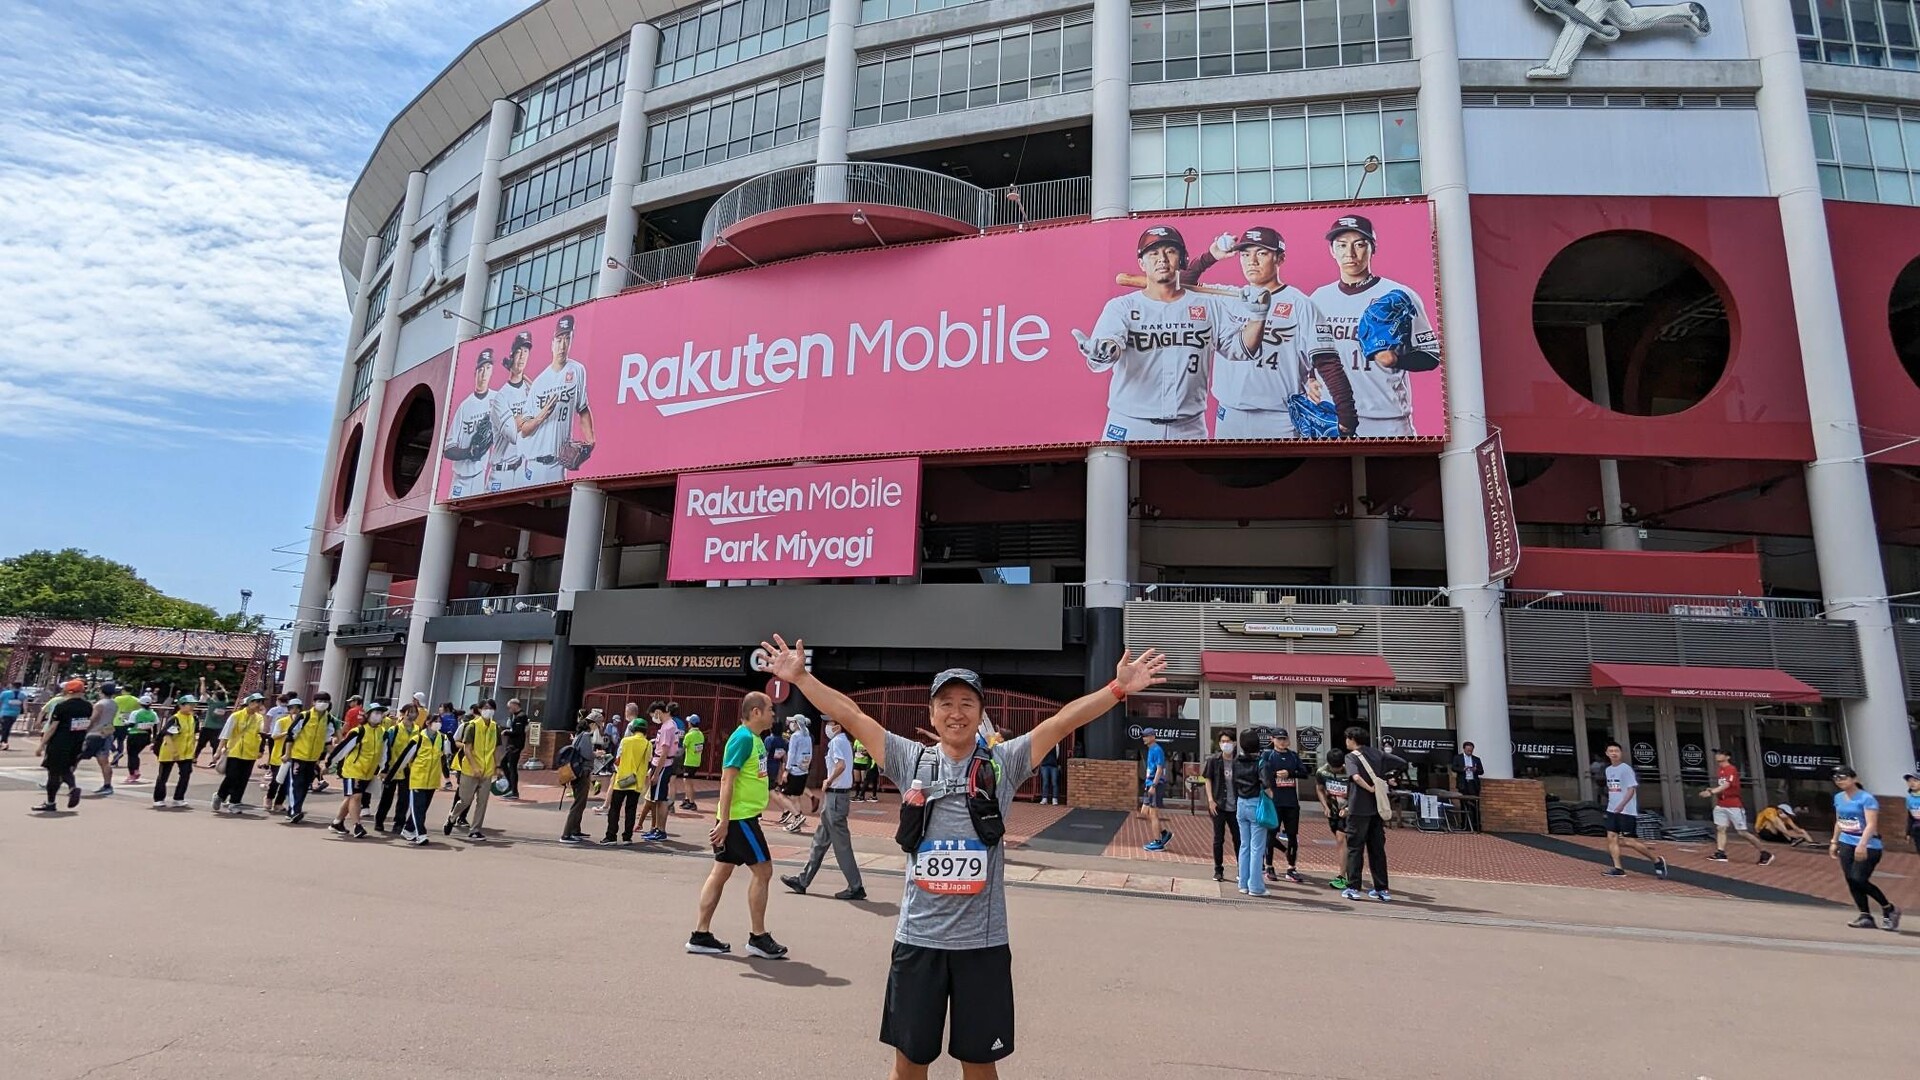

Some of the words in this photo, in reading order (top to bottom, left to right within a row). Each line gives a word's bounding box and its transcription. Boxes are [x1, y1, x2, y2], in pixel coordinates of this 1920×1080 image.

[1131, 311, 1140, 320] C
[1128, 326, 1211, 352] EAGLES
[618, 332, 834, 404] Rakuten
[847, 305, 1050, 375] Mobile
[1188, 354, 1199, 373] 3
[558, 406, 568, 421] 18
[687, 485, 803, 517] Rakuten
[808, 477, 902, 510] Mobile
[1491, 503, 1502, 560] LOUNGE
[1500, 510, 1510, 565] EAGLES
[704, 533, 770, 563] Park
[775, 527, 873, 567] Miyagi
[596, 655, 635, 666] NIKKA
[636, 655, 681, 667] WHISKY
[682, 656, 741, 668] PRESTIGE
[774, 680, 781, 698] 1
[927, 857, 982, 877] 8979
